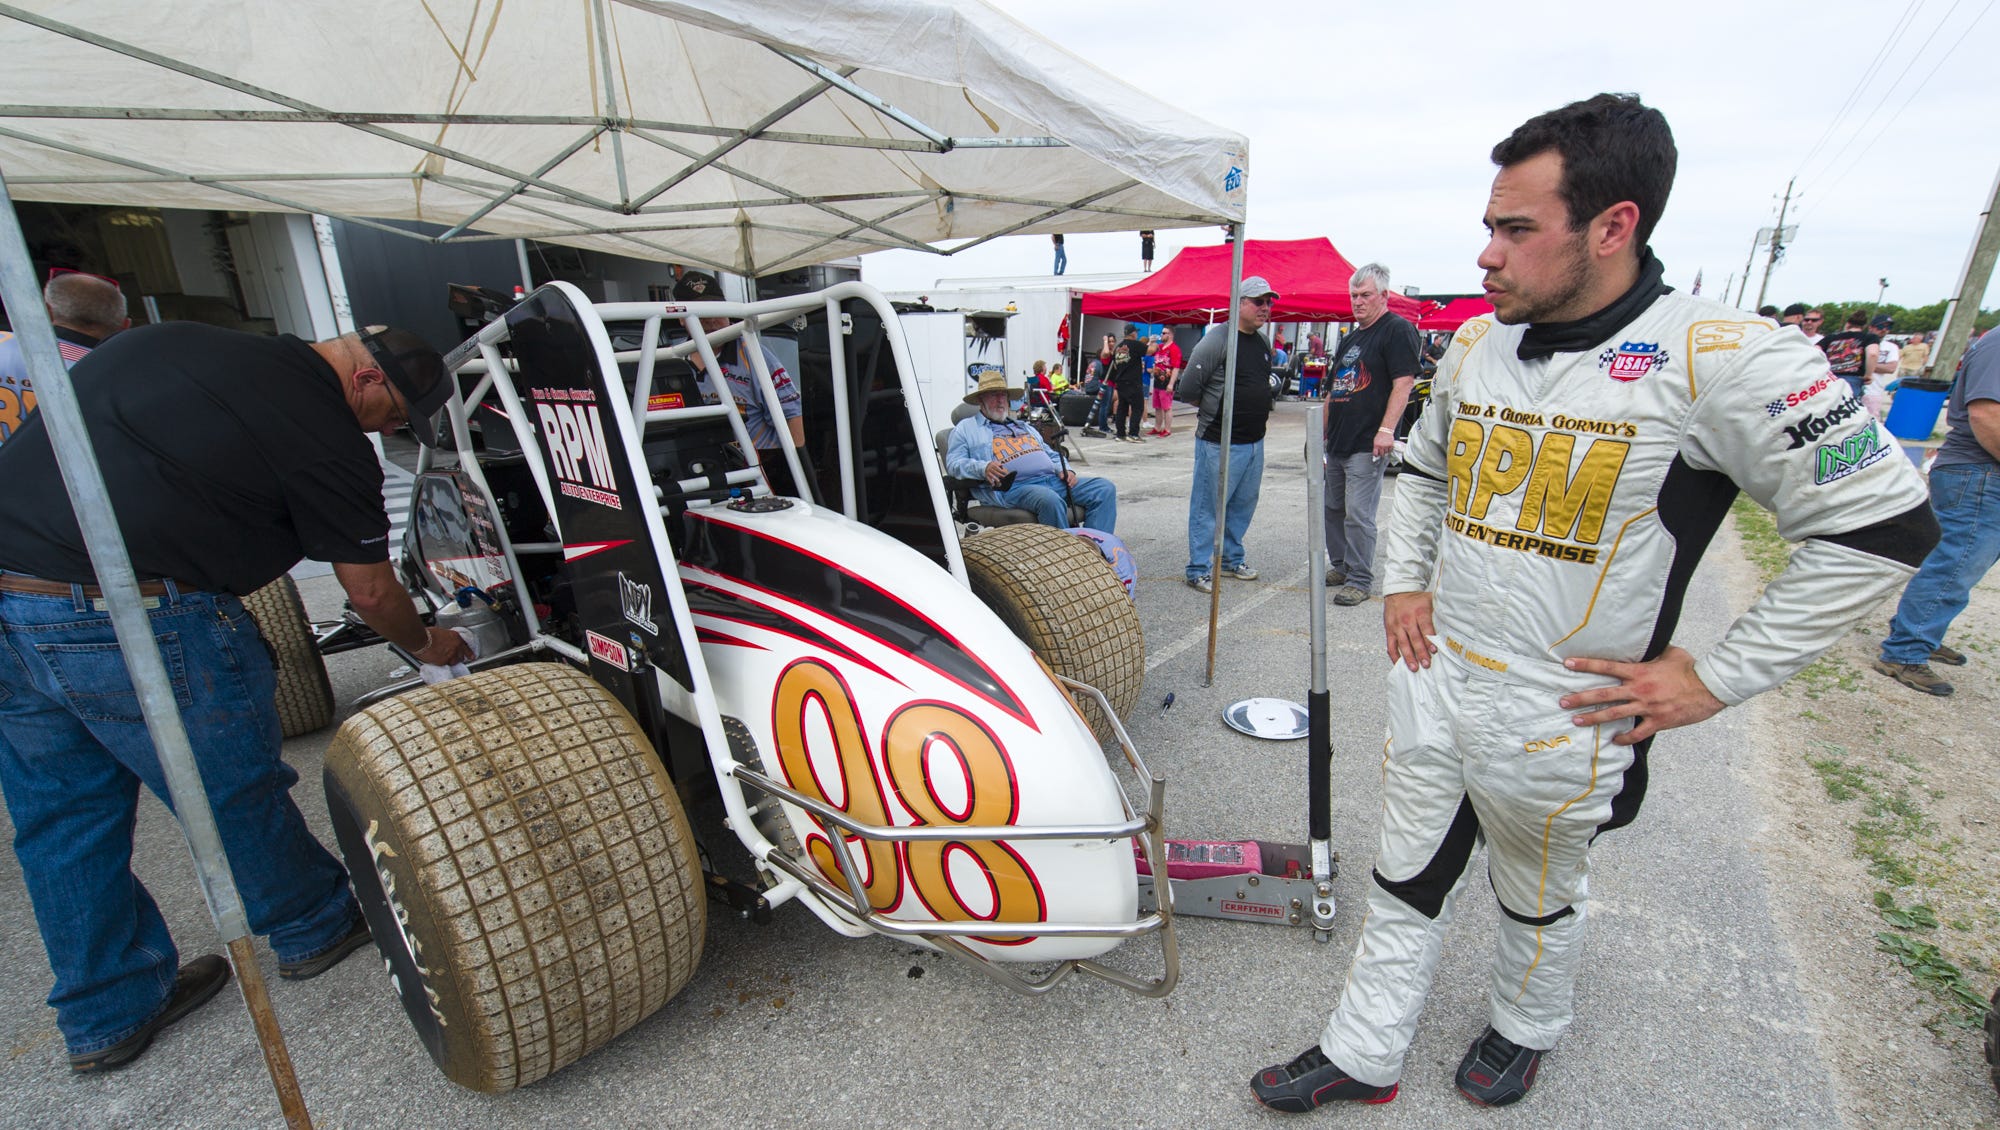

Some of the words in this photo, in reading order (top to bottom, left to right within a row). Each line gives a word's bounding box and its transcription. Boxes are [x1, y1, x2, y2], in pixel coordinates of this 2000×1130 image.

[1614, 356, 1651, 370] USAC
[1457, 401, 1481, 417] FRED
[1483, 405, 1497, 418] &
[1500, 407, 1546, 426] GLORIA
[1552, 414, 1638, 437] GORMLY'S
[536, 402, 617, 491] RPM
[1816, 418, 1879, 483] INDY
[561, 483, 579, 498] AUTO
[579, 486, 621, 509] ENTERPRISE
[1446, 418, 1632, 545] RPM
[1466, 523, 1600, 565] ENTERPRISE
[589, 636, 625, 665] SIMPSON
[772, 656, 1047, 946] 98
[1225, 903, 1281, 916] CRAFTSMAN
